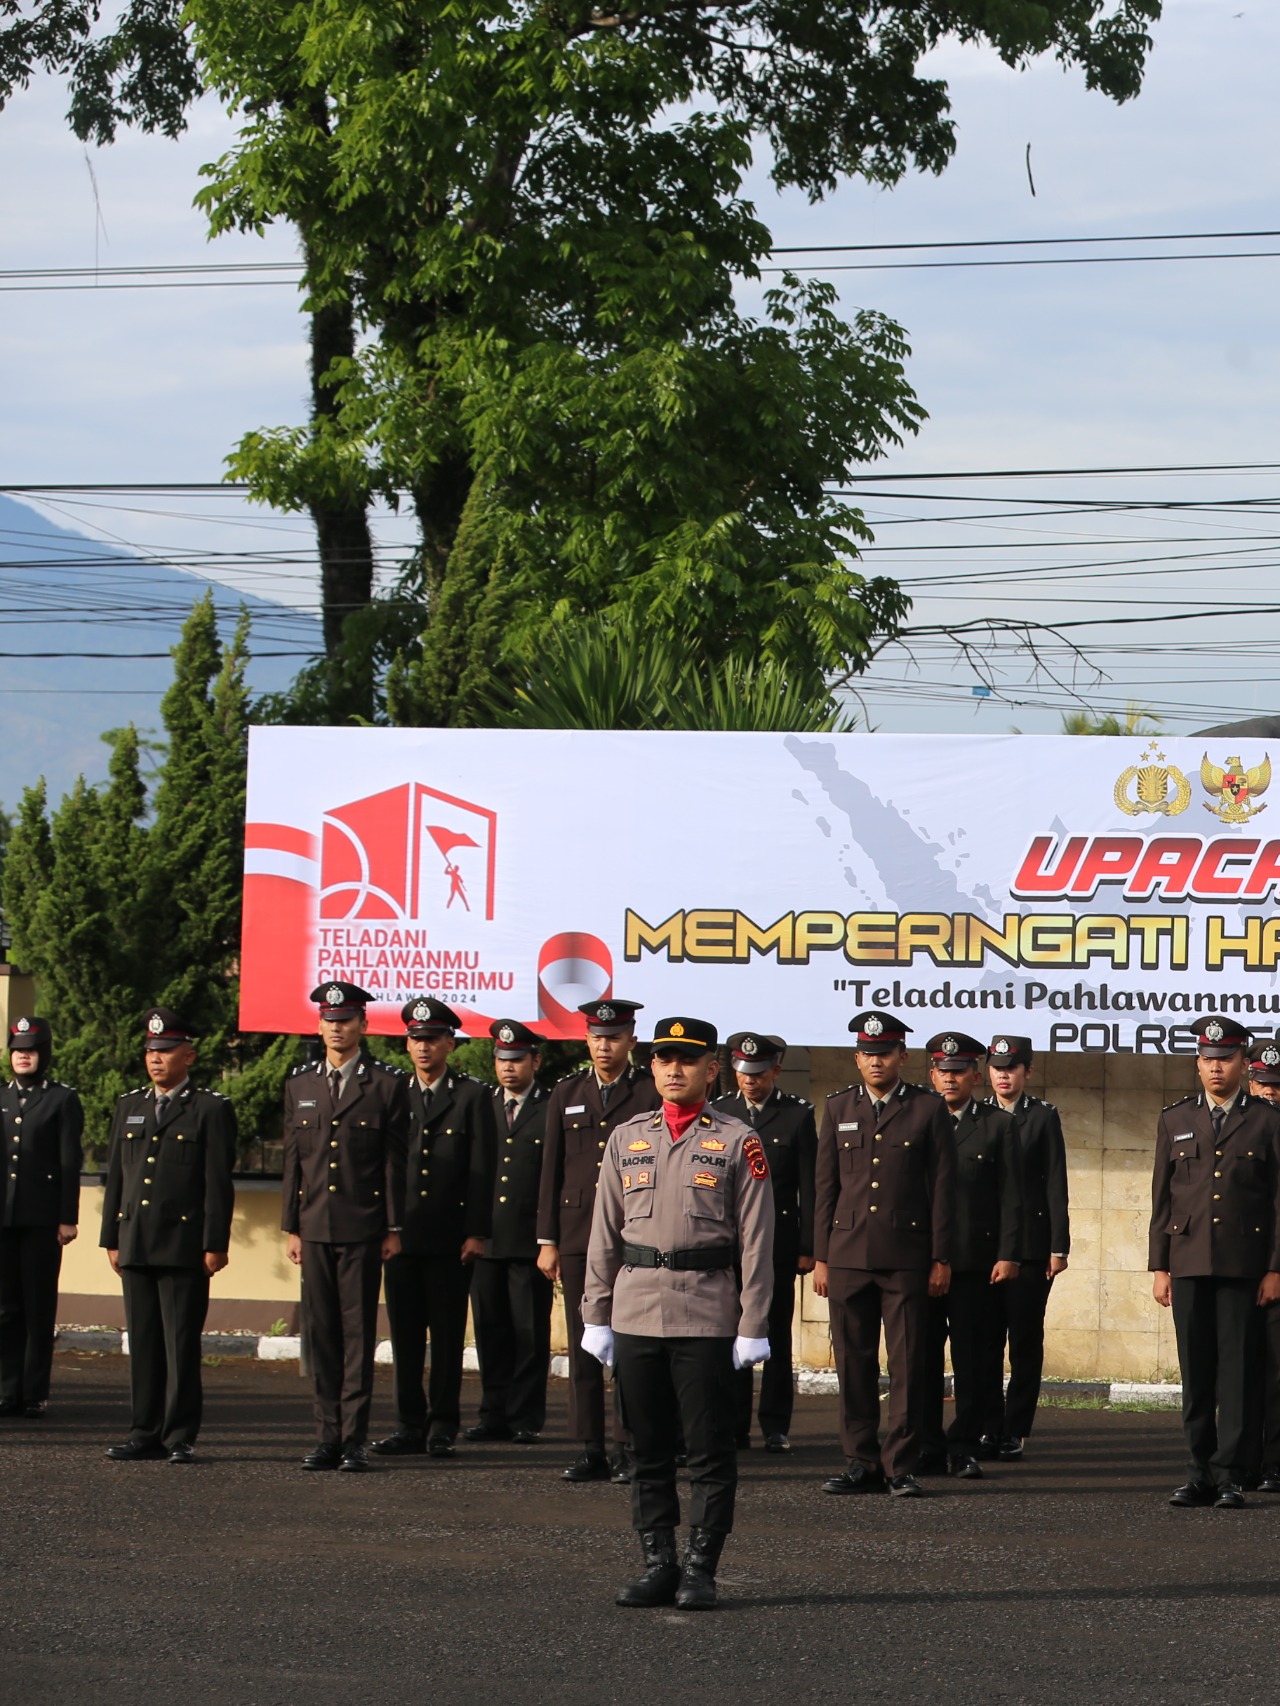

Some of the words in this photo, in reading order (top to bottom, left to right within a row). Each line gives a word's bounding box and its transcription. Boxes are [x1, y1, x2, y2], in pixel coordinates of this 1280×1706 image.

[319, 928, 427, 948] TELADANI
[625, 909, 1189, 969] MEMPERINGATI
[318, 949, 479, 969] PAHLAWANMU
[317, 969, 389, 989] CINTAI
[396, 971, 514, 991] NEGERIMU
[366, 992, 437, 1003] HLAWN
[441, 993, 477, 1004] 2024
[833, 979, 1016, 1008] "Teladani
[1050, 1022, 1202, 1055] POLRE
[622, 1156, 655, 1167] BACHRIE
[691, 1153, 727, 1168] POLRI
